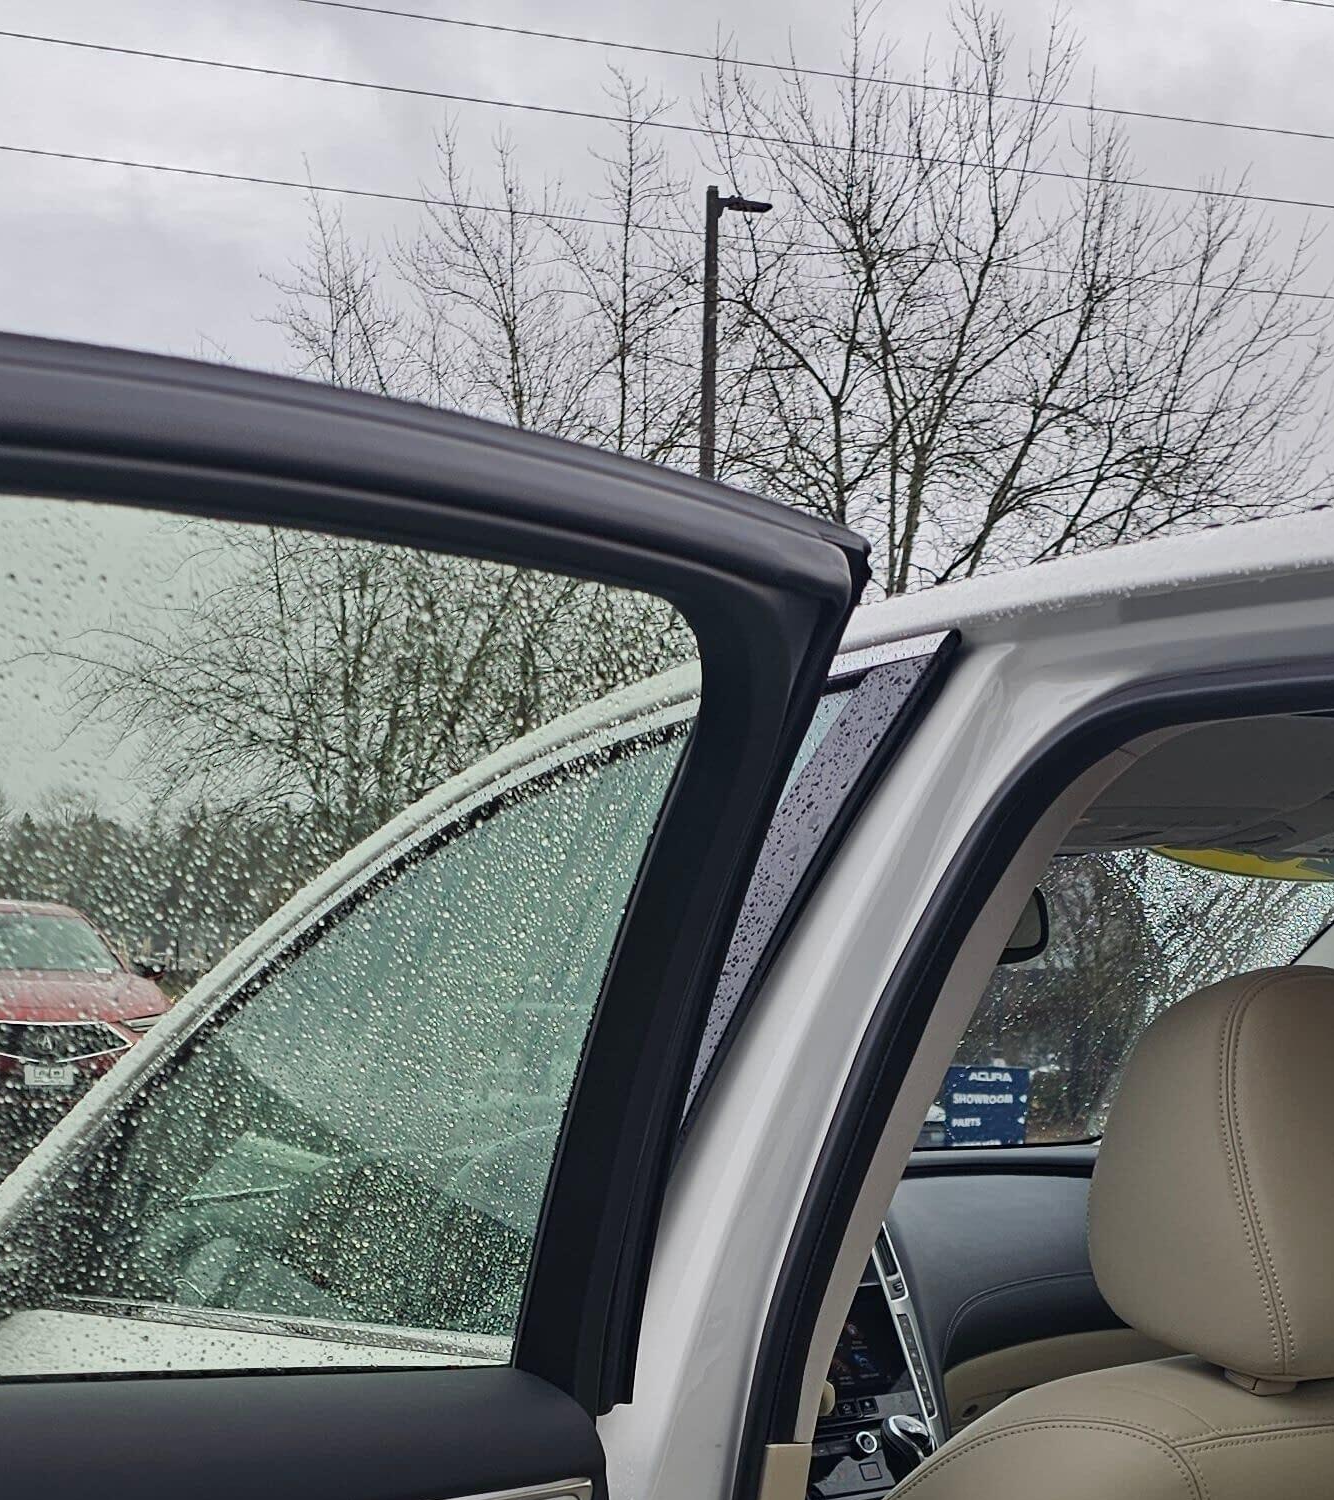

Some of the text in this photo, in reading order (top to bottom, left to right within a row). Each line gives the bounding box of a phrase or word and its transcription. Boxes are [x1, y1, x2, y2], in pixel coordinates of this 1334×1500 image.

[968, 1071, 1013, 1083] ACURA
[952, 1093, 1014, 1105] SHOWROOM
[951, 1117, 982, 1128] PARTS
